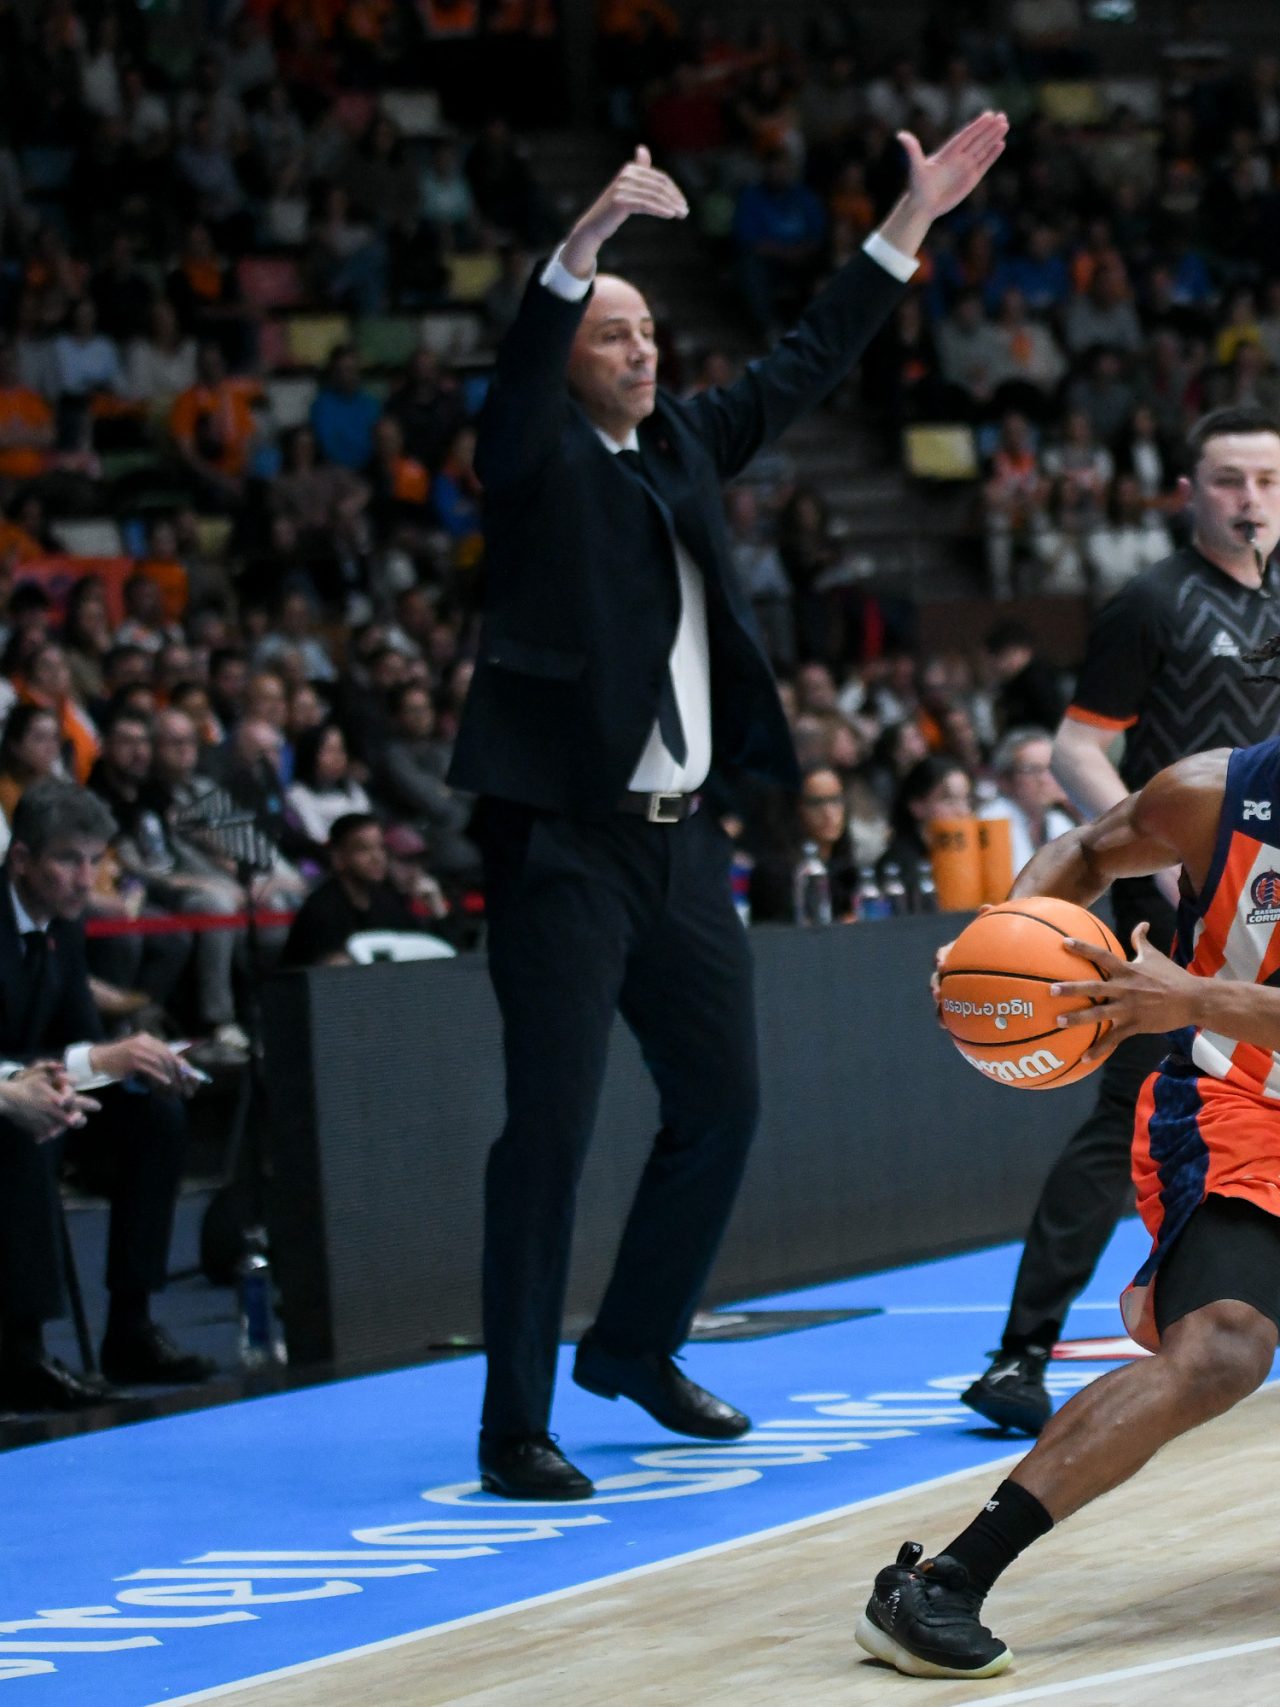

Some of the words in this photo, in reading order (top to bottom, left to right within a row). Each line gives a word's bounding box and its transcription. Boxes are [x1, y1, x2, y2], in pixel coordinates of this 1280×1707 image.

[1243, 800, 1271, 820] PG
[944, 999, 994, 1017] endesa
[997, 999, 1033, 1018] liga
